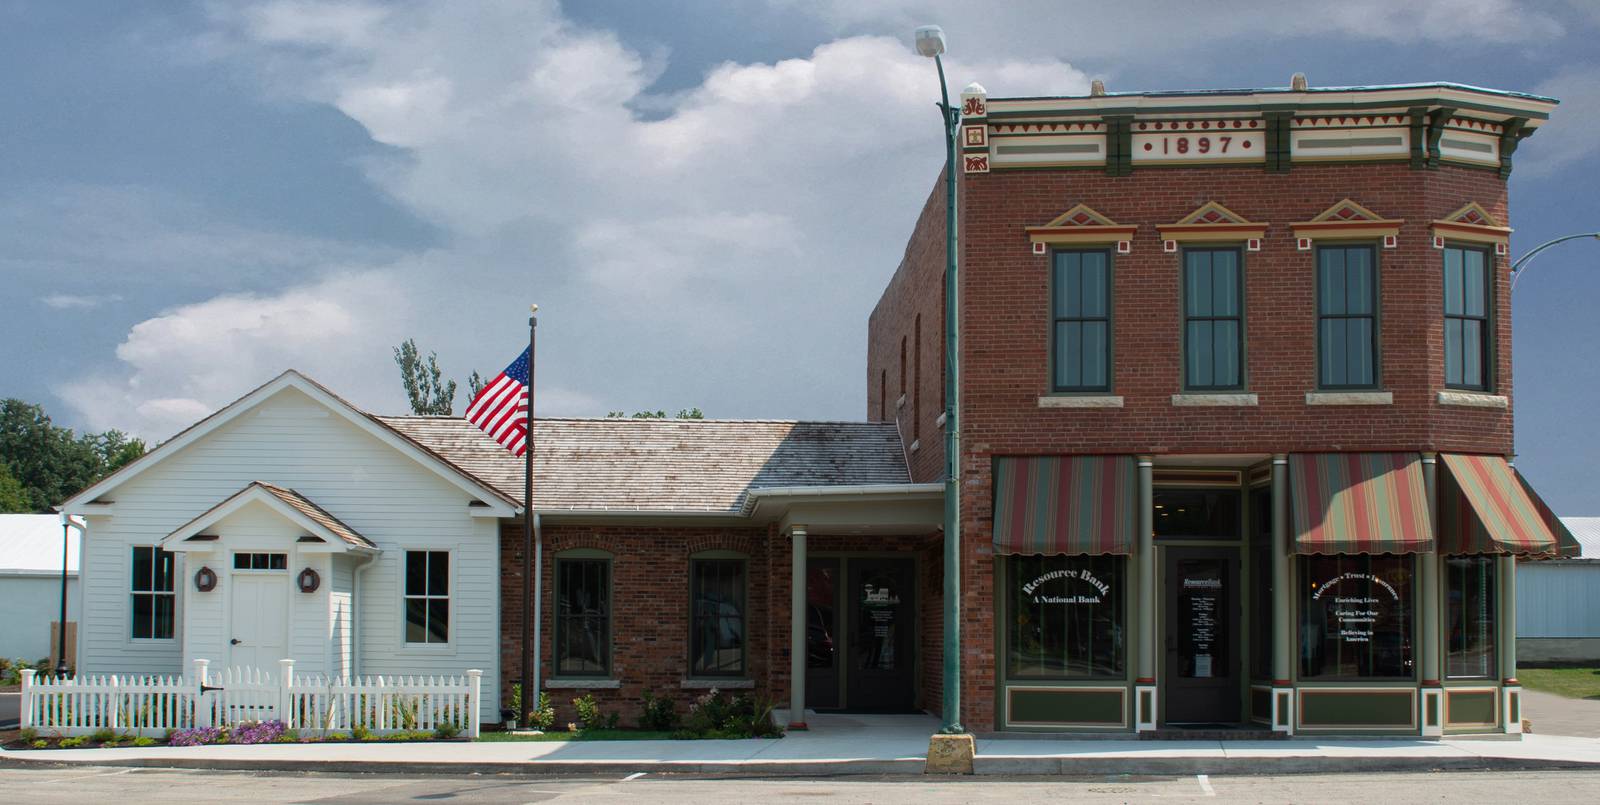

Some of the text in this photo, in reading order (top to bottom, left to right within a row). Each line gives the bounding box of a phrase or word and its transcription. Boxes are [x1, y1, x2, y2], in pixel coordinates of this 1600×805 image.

[1163, 137, 1232, 155] 1897
[1022, 569, 1110, 597] Resource Bank
[1041, 595, 1076, 604] National
[1078, 595, 1101, 604] Bank
